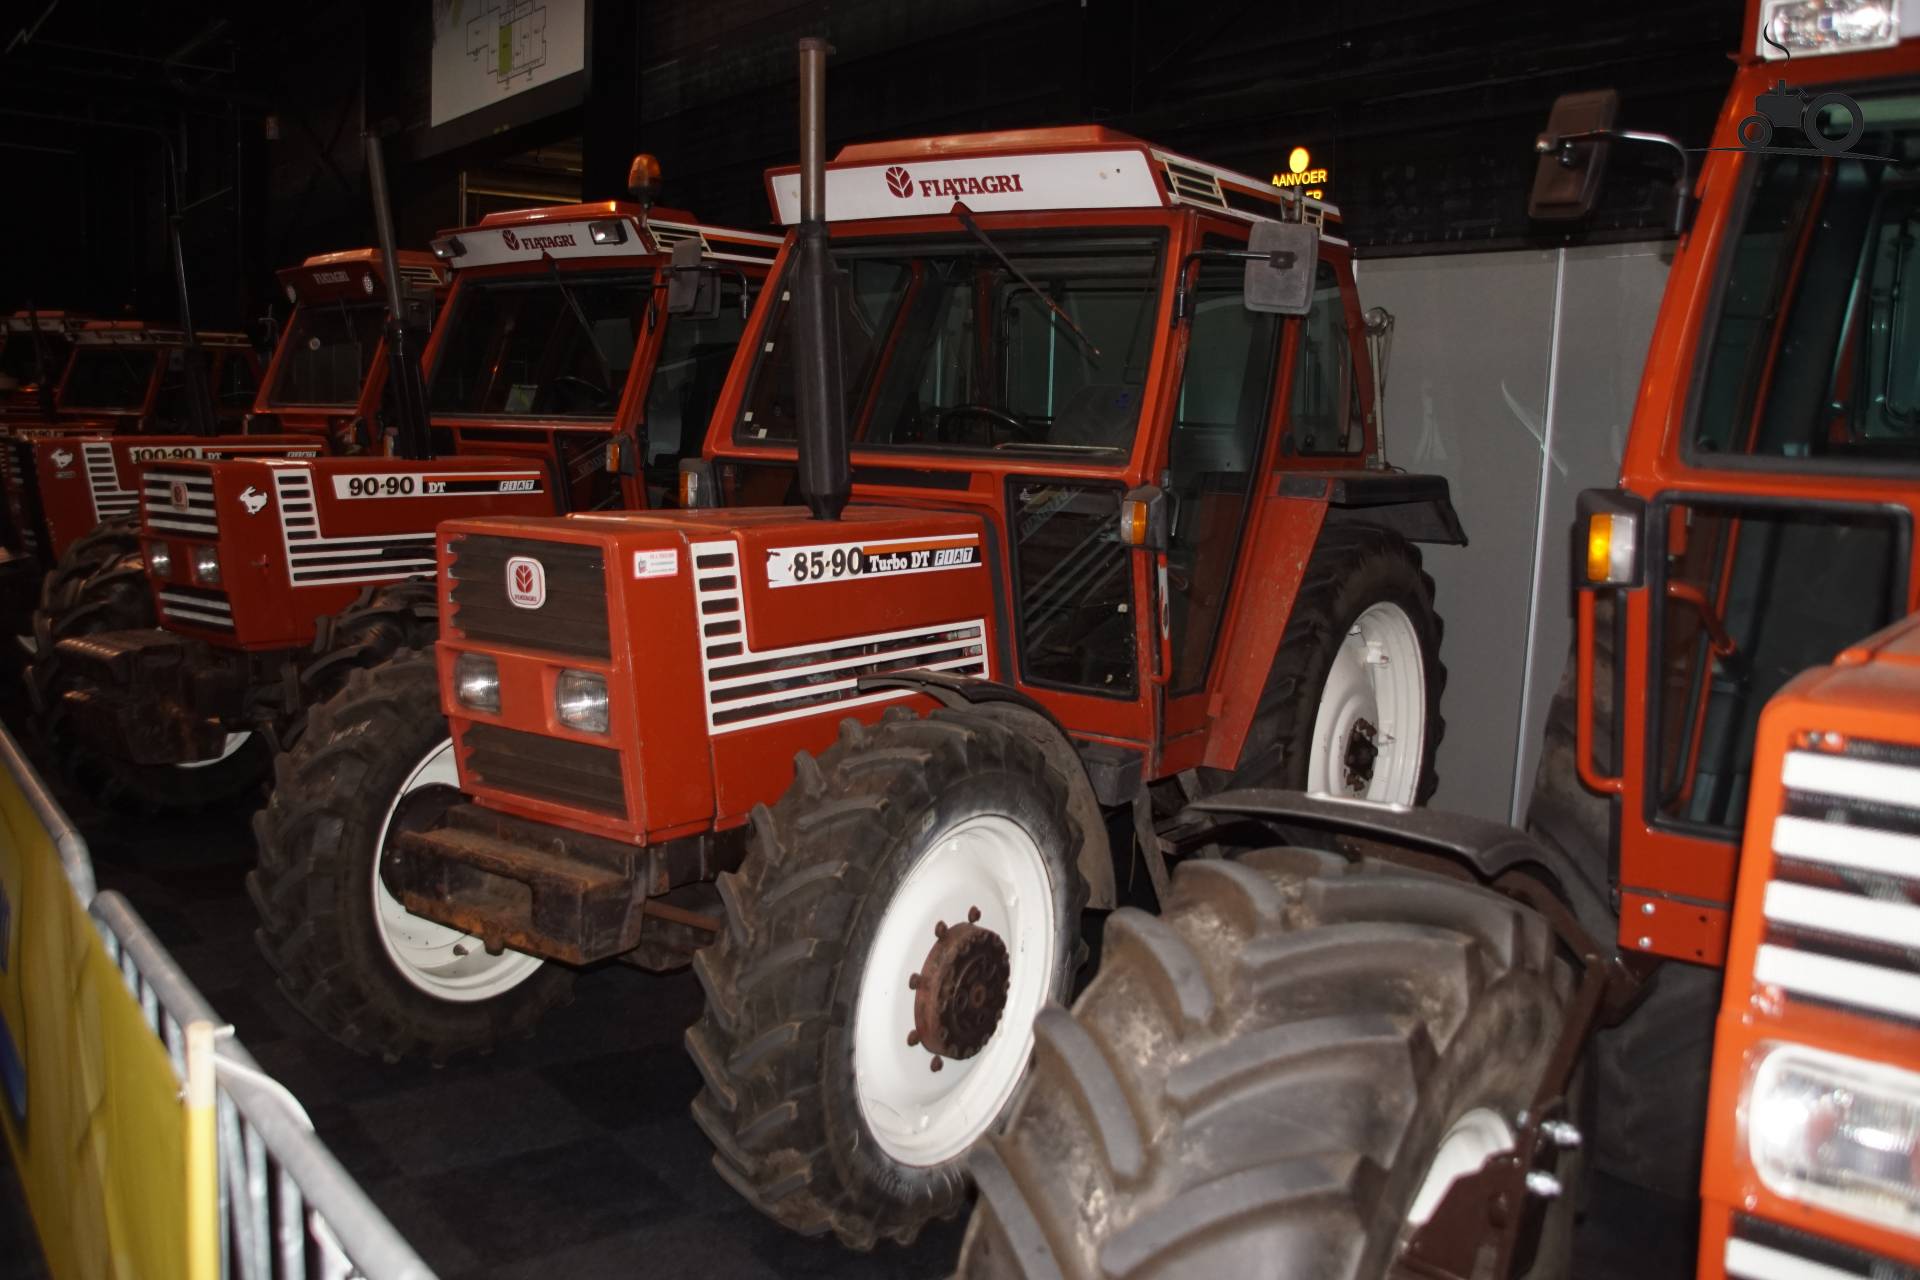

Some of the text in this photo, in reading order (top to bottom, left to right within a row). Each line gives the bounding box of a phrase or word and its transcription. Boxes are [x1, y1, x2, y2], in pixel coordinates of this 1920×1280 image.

[919, 174, 1023, 197] FIATAGRI
[1272, 169, 1327, 187] AANVOER
[521, 234, 577, 250] FIATAGRI
[349, 476, 535, 496] 90-90 DT FIAT
[793, 547, 974, 581] 85-90 Turbo DT FIAT
